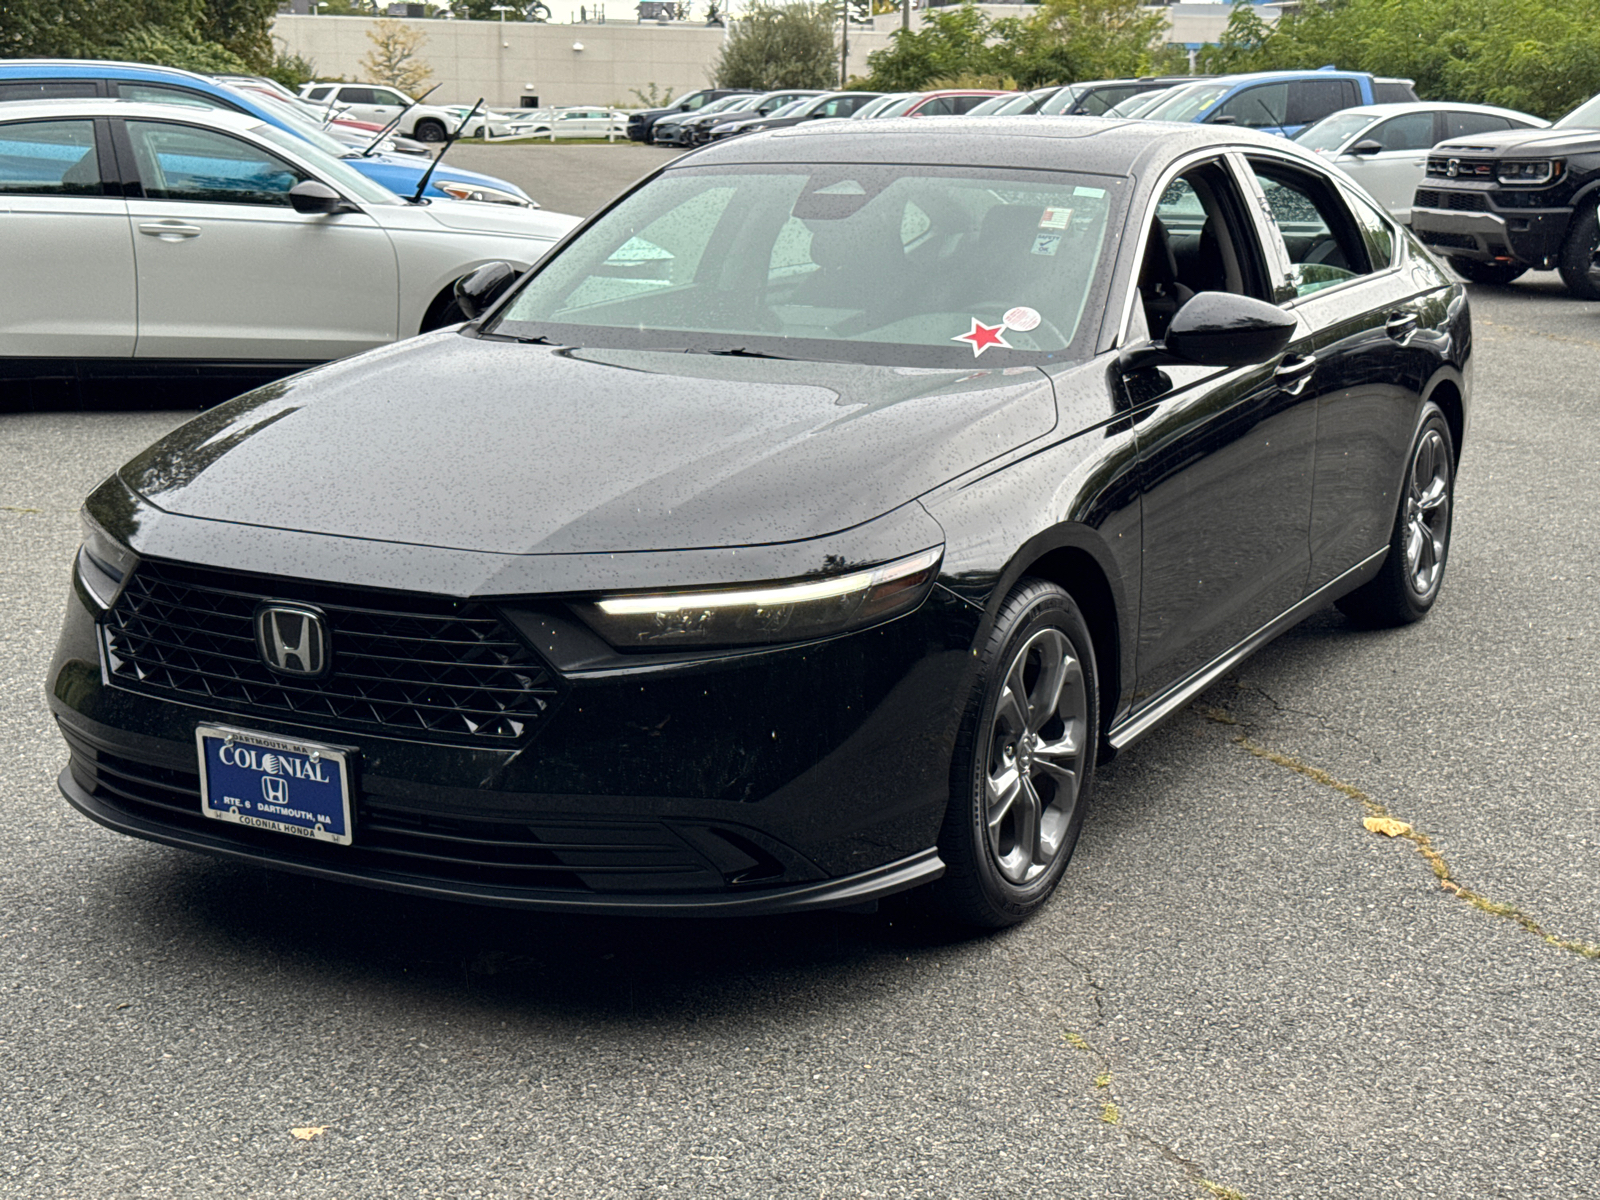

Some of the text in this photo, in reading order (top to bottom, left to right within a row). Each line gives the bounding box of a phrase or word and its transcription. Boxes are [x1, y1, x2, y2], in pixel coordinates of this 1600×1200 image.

[293, 745, 308, 754] MA
[219, 743, 330, 783] COLONIAL
[224, 796, 332, 825] RTE. 6 DARTMOUTH, MA
[239, 815, 315, 838] COLONIAL HONDA
